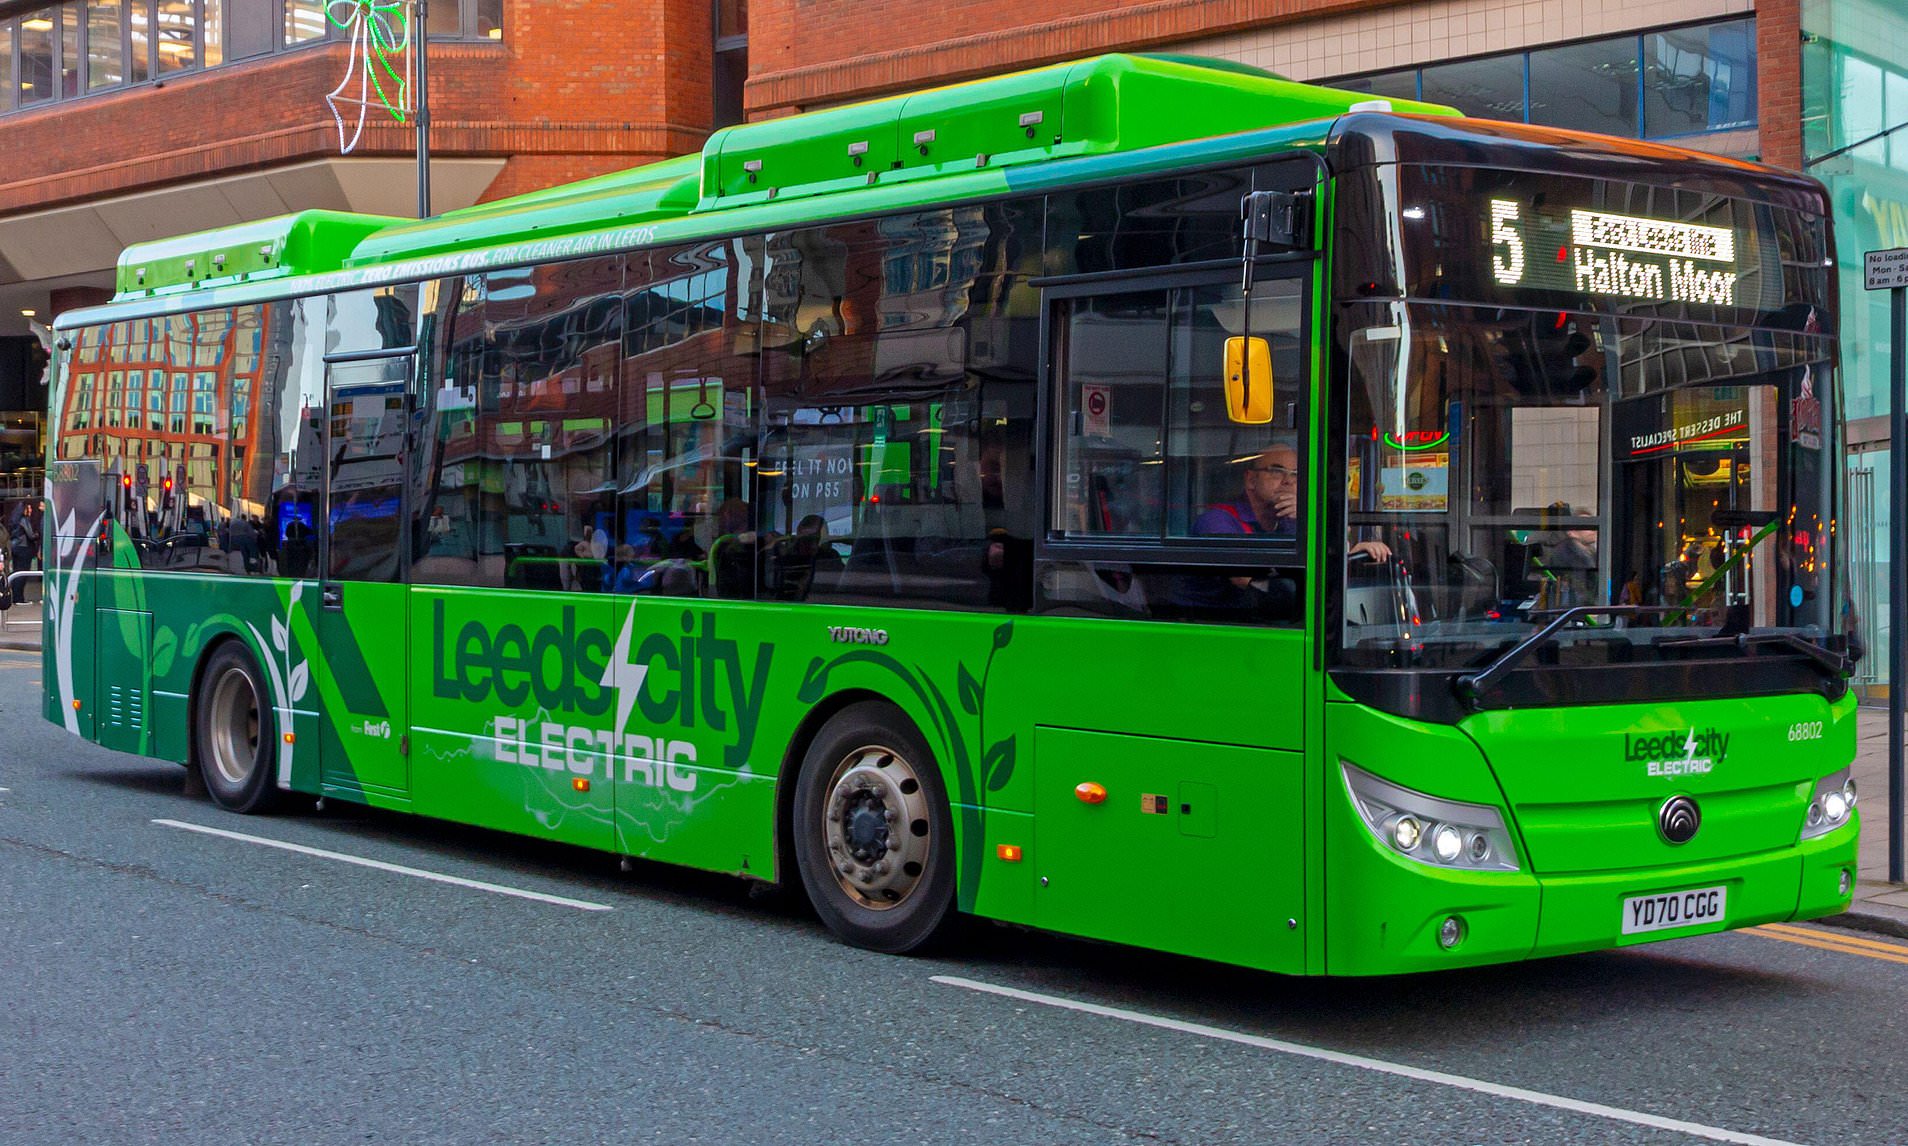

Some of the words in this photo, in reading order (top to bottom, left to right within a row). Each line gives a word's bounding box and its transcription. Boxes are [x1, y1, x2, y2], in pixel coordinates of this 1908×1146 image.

[360, 264, 393, 282] ZERO
[394, 256, 459, 279] EMISSIONS
[460, 250, 489, 269] BUS.
[492, 246, 518, 264] FOR
[518, 238, 574, 261] CLEANER
[573, 234, 597, 252] AIR
[597, 231, 614, 249] IN
[615, 226, 658, 248] LEEDS
[1491, 199, 1525, 285] 5
[1869, 255, 1882, 263] No
[1573, 247, 1663, 300] Halton
[1669, 258, 1737, 306] Moor
[1872, 266, 1892, 274] Mon
[792, 483, 810, 498] ON
[816, 481, 840, 498] PS5
[827, 625, 890, 646] YUTONG
[433, 598, 613, 717] Leeds
[635, 608, 776, 768] city
[1625, 730, 1686, 762] Leeds
[1695, 727, 1730, 764] city
[1787, 720, 1824, 742] 68802
[493, 715, 698, 793] ELECTRIC
[1647, 758, 1713, 776] ELECTRIC
[1632, 895, 1679, 927] YD70
[1683, 890, 1719, 918] CGG
